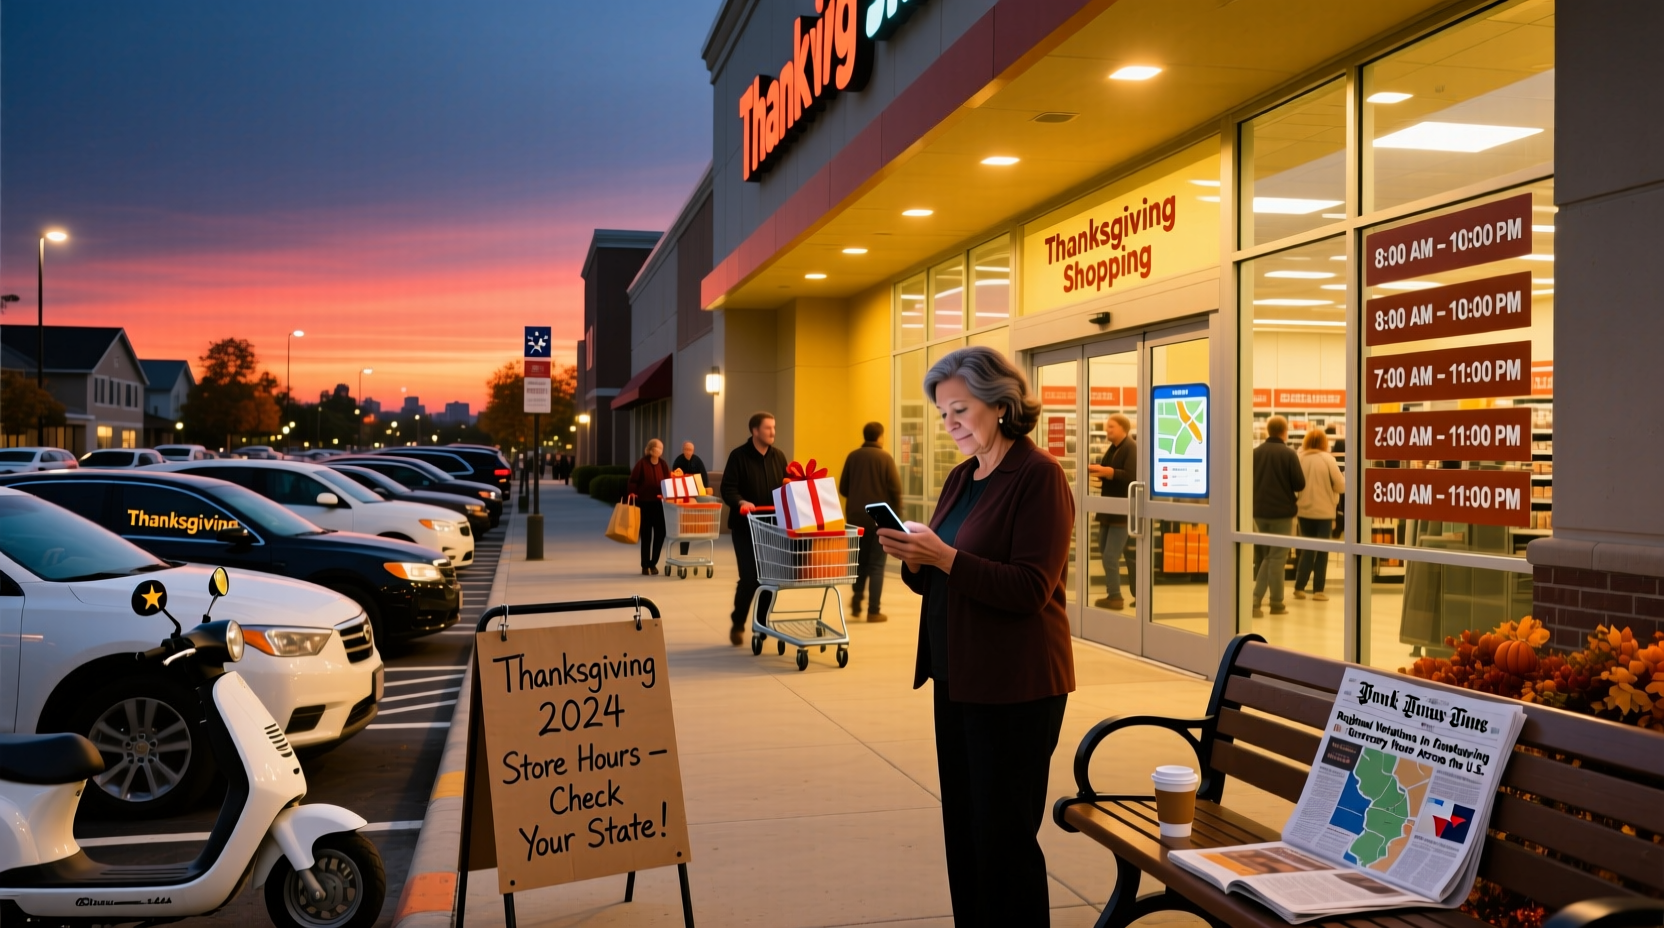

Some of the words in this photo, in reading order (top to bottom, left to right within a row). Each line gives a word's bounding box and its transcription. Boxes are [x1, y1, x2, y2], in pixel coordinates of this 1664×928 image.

[1045, 195, 1176, 265] Thanksgiving
[1375, 243, 1406, 268] 8:00
[1410, 237, 1433, 261] AM
[1449, 223, 1493, 253] 10:00
[1496, 217, 1522, 243] PM
[1063, 245, 1151, 293] Shopping
[1375, 308, 1405, 331] 8:00
[1410, 303, 1432, 326] AM
[1449, 295, 1492, 321] 10:00
[1496, 290, 1521, 314] PM
[1374, 367, 1405, 389] 7:00
[1409, 365, 1432, 387] AM
[1449, 361, 1492, 384] 11:00
[1495, 359, 1521, 381] PM
[1409, 426, 1432, 446] AM
[1449, 424, 1491, 447] 11:00
[1495, 425, 1520, 447] PM
[1373, 482, 1404, 503] 8:00
[1409, 484, 1432, 505] AM
[1449, 485, 1491, 508] 11:00
[1495, 487, 1520, 510] PM
[493, 652, 655, 693] Thanksgiving
[538, 694, 625, 737] 2024
[503, 751, 567, 784] Store
[578, 743, 641, 772] Hours
[550, 779, 624, 815] Check
[519, 825, 575, 861] Your
[588, 801, 667, 848] State!
